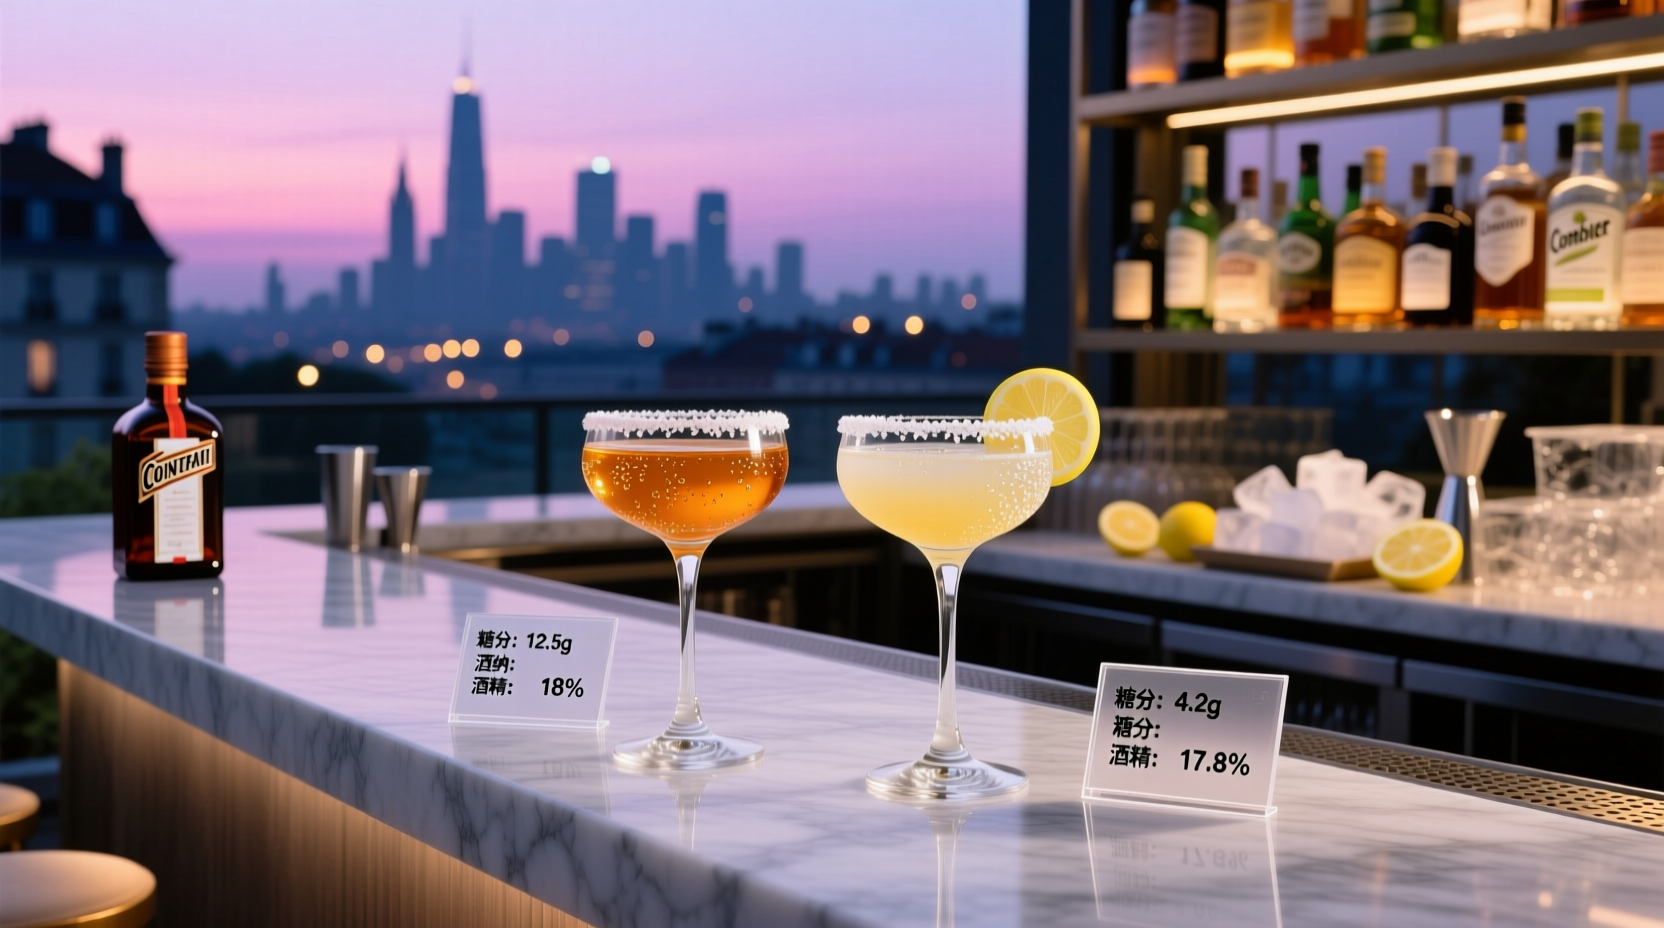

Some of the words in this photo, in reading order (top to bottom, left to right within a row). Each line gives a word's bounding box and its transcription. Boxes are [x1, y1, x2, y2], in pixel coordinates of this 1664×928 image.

[526, 632, 573, 655] 12.5g
[541, 677, 584, 698] 18%
[1174, 691, 1222, 719] 4.2g
[1180, 749, 1250, 776] 17.8%
